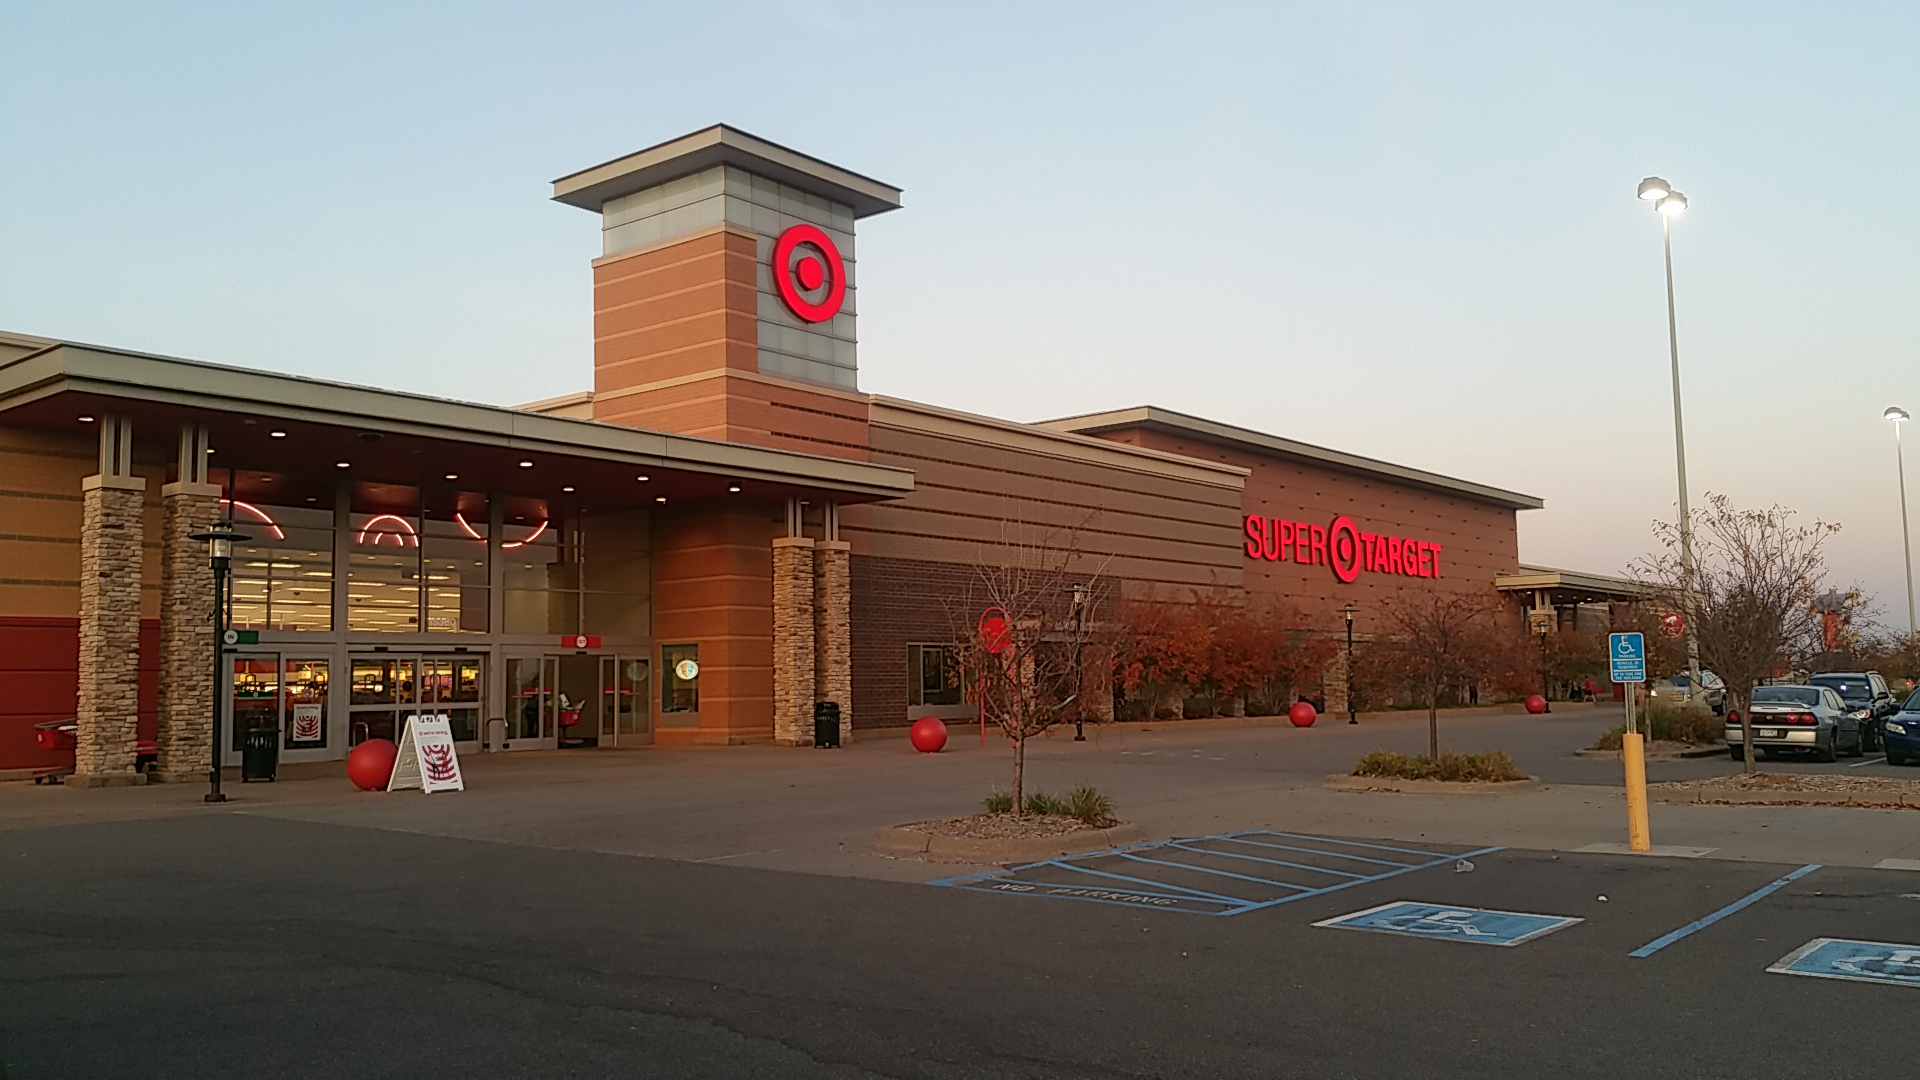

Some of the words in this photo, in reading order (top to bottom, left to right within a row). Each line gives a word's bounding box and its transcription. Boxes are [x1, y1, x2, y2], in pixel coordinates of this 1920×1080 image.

[1245, 514, 1327, 566] SUPER
[1359, 532, 1442, 578] TARGET
[992, 883, 1036, 892] NO
[1046, 888, 1178, 905] PARKING
